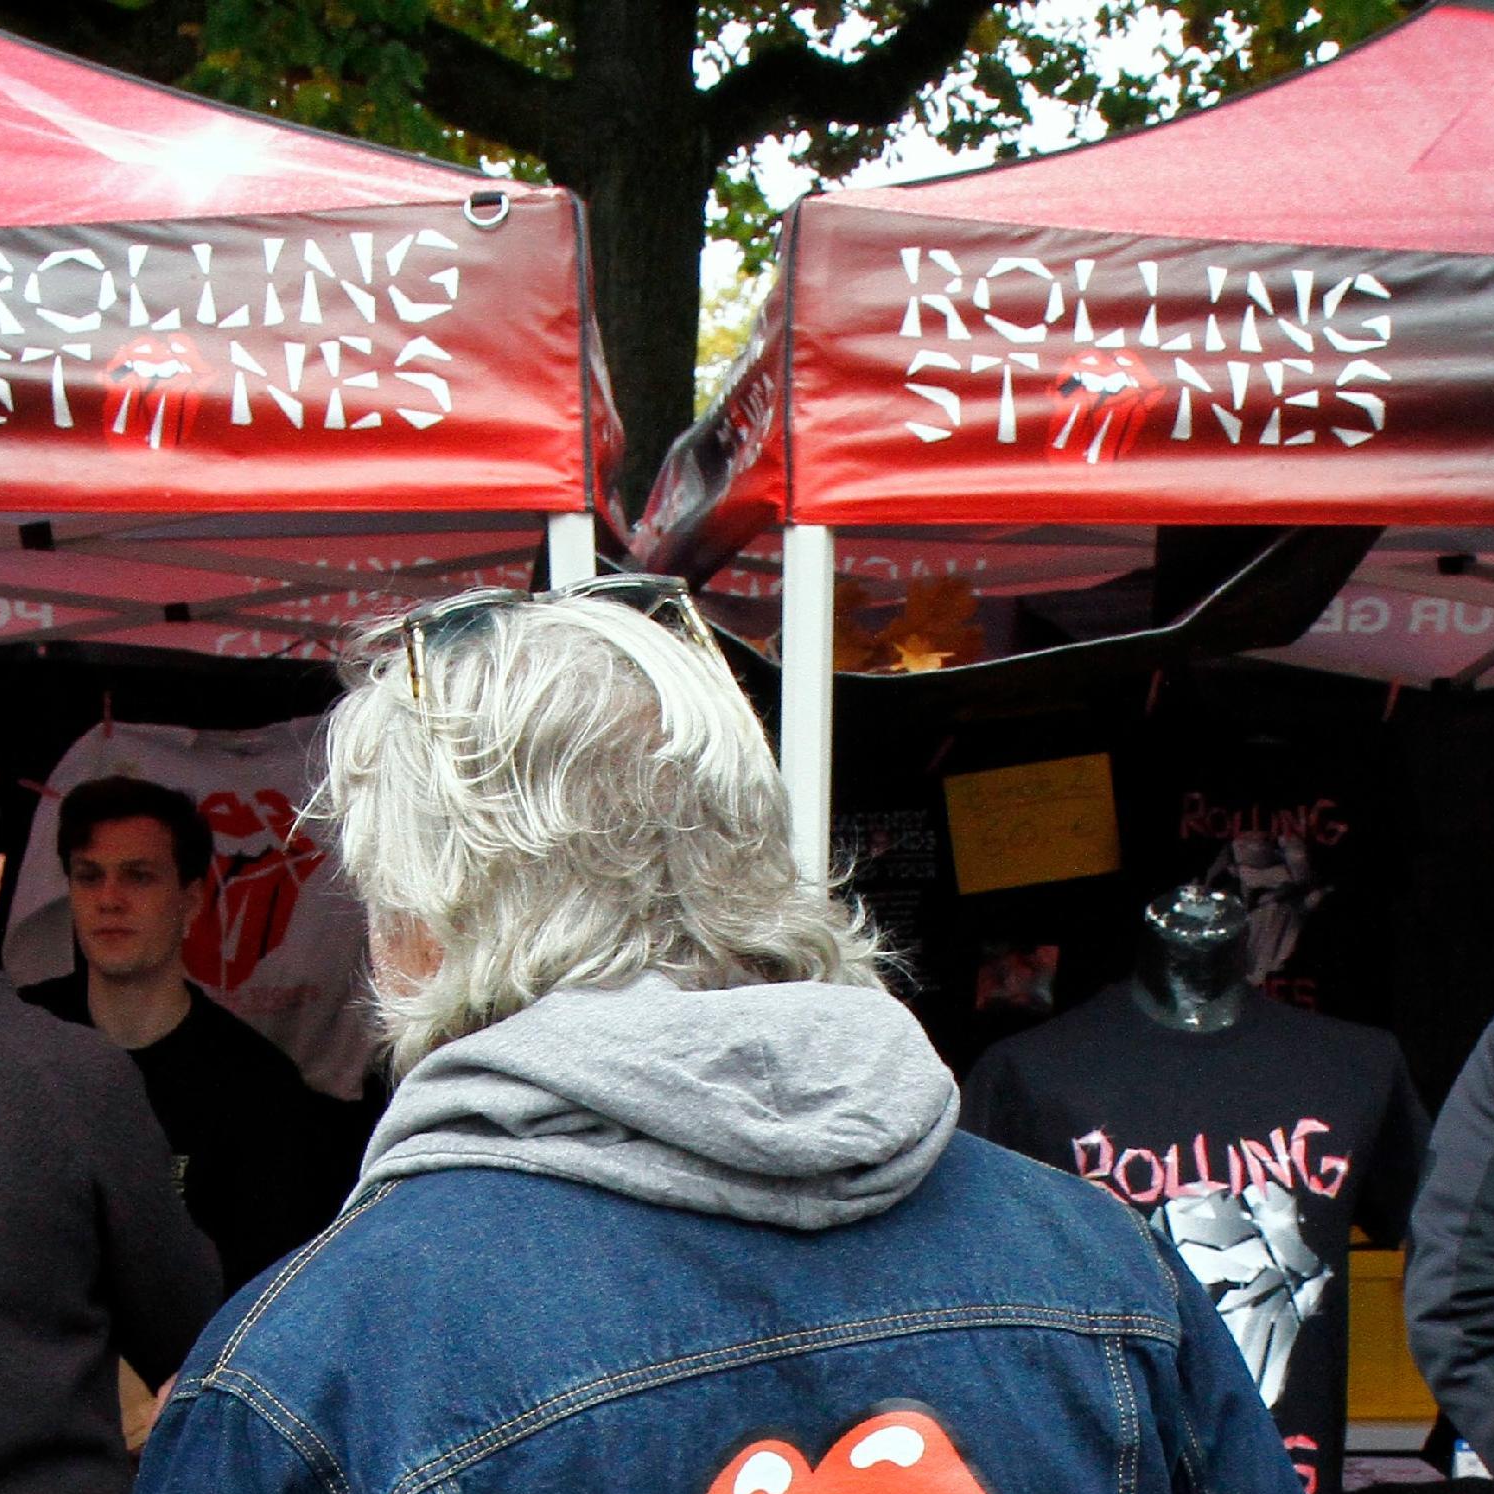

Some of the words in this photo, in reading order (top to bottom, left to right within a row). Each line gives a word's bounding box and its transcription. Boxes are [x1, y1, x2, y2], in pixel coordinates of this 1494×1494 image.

[899, 247, 1392, 353] ROLLING
[904, 350, 1393, 464] STNES
[1178, 788, 1352, 848] ROLLING
[1071, 1116, 1350, 1204] ROLLING
